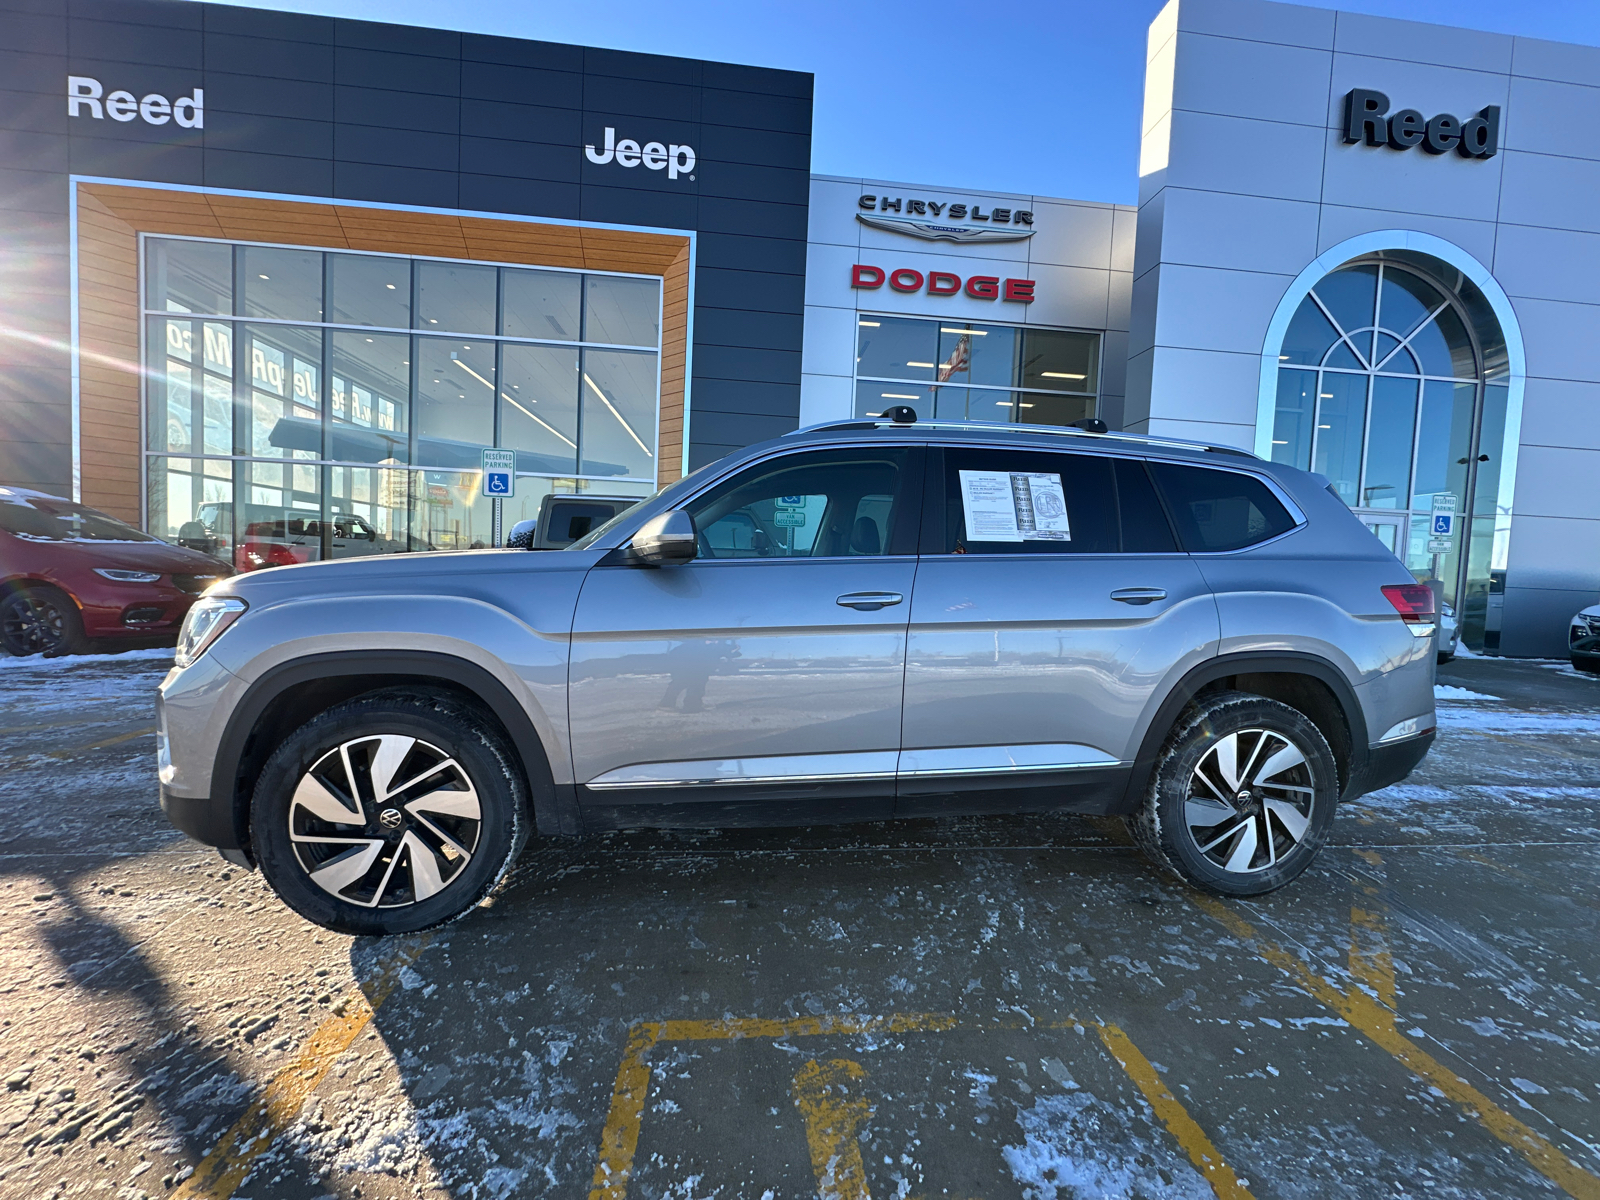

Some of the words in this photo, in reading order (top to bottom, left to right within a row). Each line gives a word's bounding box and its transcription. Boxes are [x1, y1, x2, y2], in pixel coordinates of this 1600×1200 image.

[67, 75, 204, 129] Reed
[1343, 88, 1501, 160] Reed
[585, 126, 696, 180] Jeep
[858, 194, 1035, 225] CHRYSLER
[851, 264, 1036, 304] DODGE
[485, 452, 513, 461] RESERVED
[485, 461, 513, 470] PARKING
